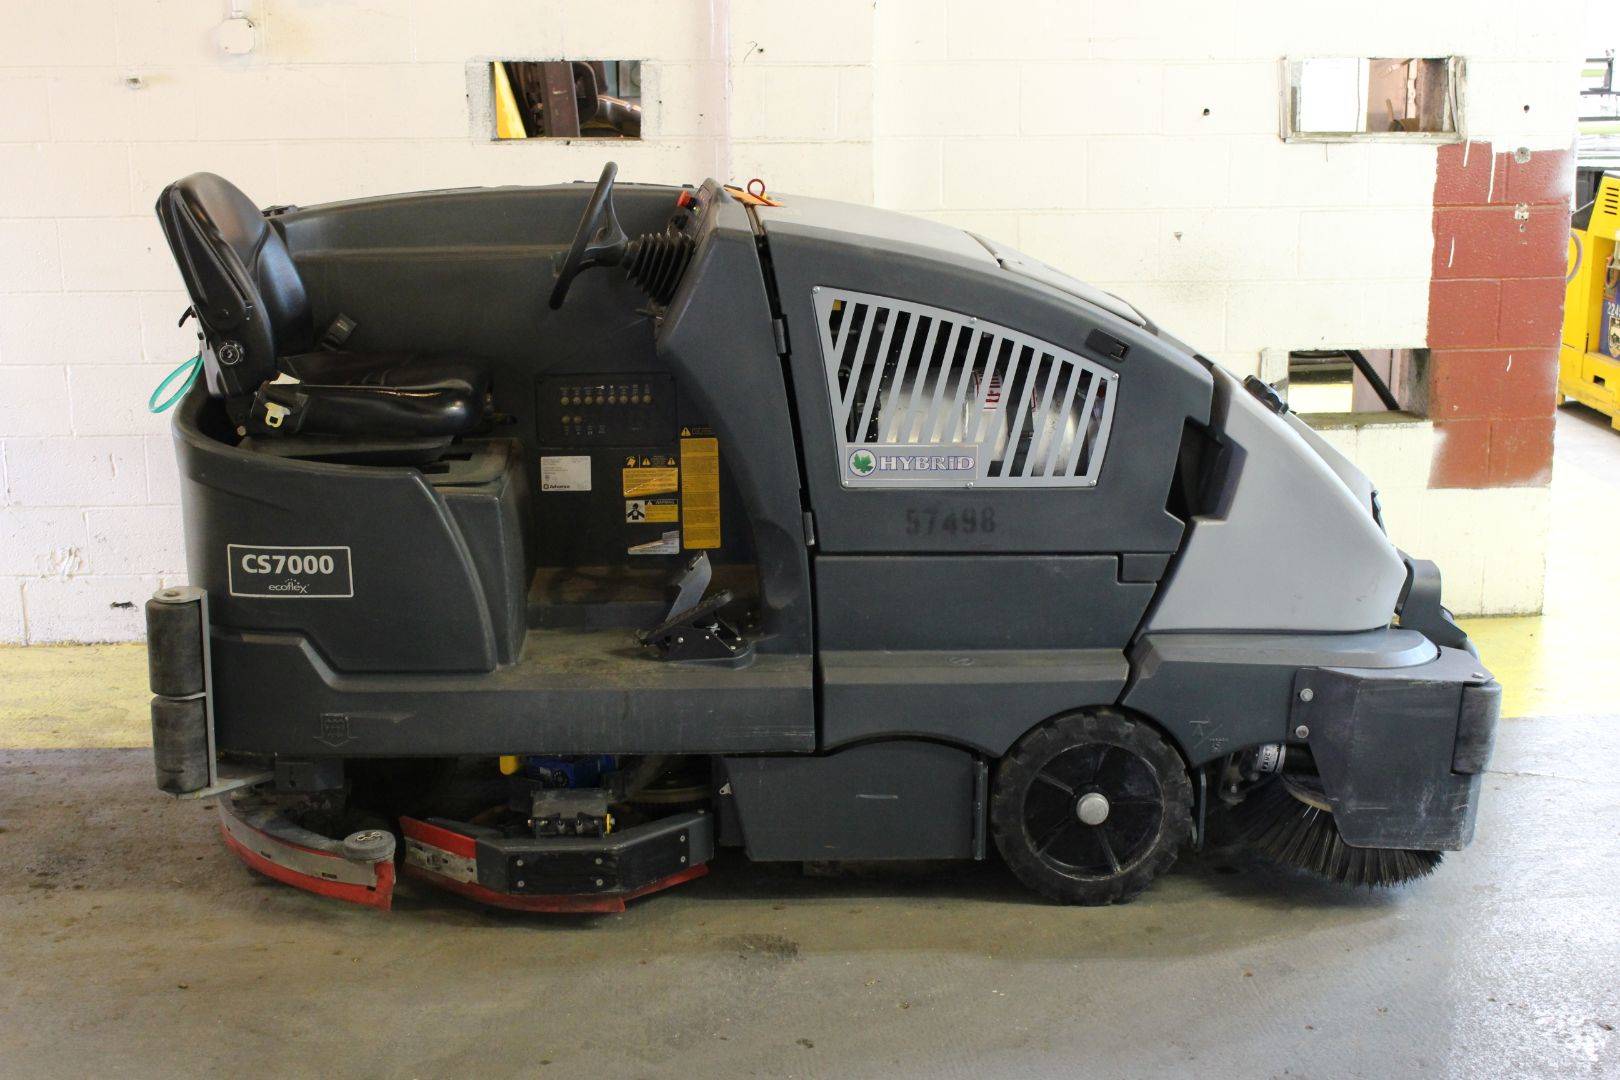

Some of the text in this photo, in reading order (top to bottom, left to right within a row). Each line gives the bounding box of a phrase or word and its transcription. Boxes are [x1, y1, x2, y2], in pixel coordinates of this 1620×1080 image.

[879, 455, 976, 471] HYBRID
[905, 504, 996, 535] 57498
[241, 553, 335, 575] CS7000
[268, 581, 308, 594] ecoflex
